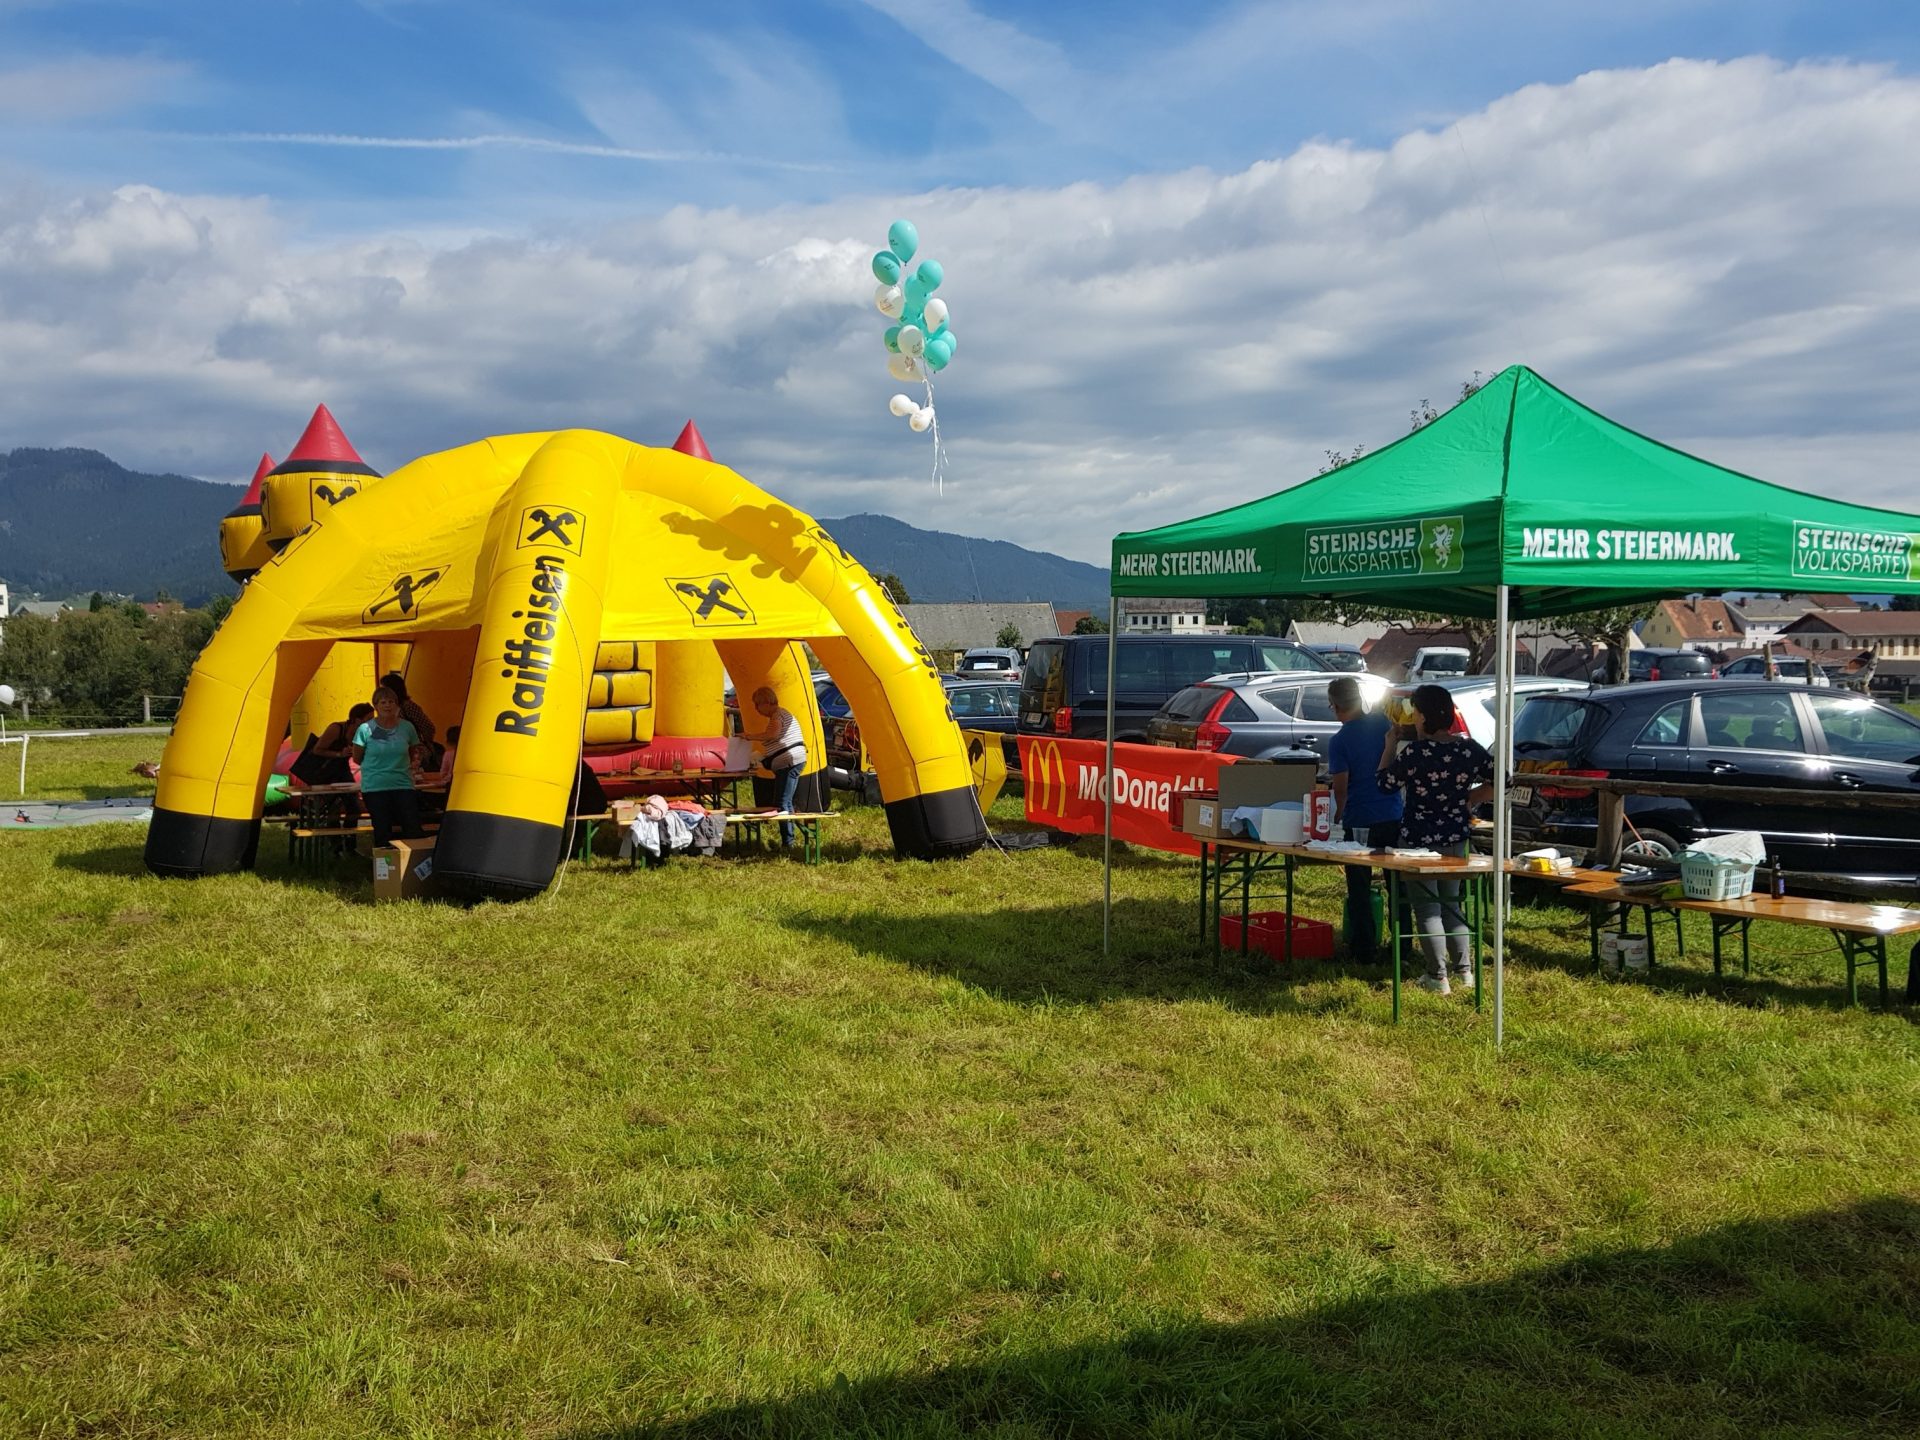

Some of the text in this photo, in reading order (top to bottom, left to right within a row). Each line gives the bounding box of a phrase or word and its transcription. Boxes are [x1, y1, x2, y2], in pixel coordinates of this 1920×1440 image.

[1309, 527, 1417, 554] STEIRISCHE
[1522, 528, 1741, 561] MEHR STEIERMARK.
[1798, 528, 1908, 554] STEIRISCHE
[1119, 548, 1262, 577] MEHR STEIERMARK.
[1308, 549, 1417, 575] VOLKSPARTEI
[1798, 549, 1907, 575] VOLKSPARTEI
[494, 555, 565, 737] Raiffeisen
